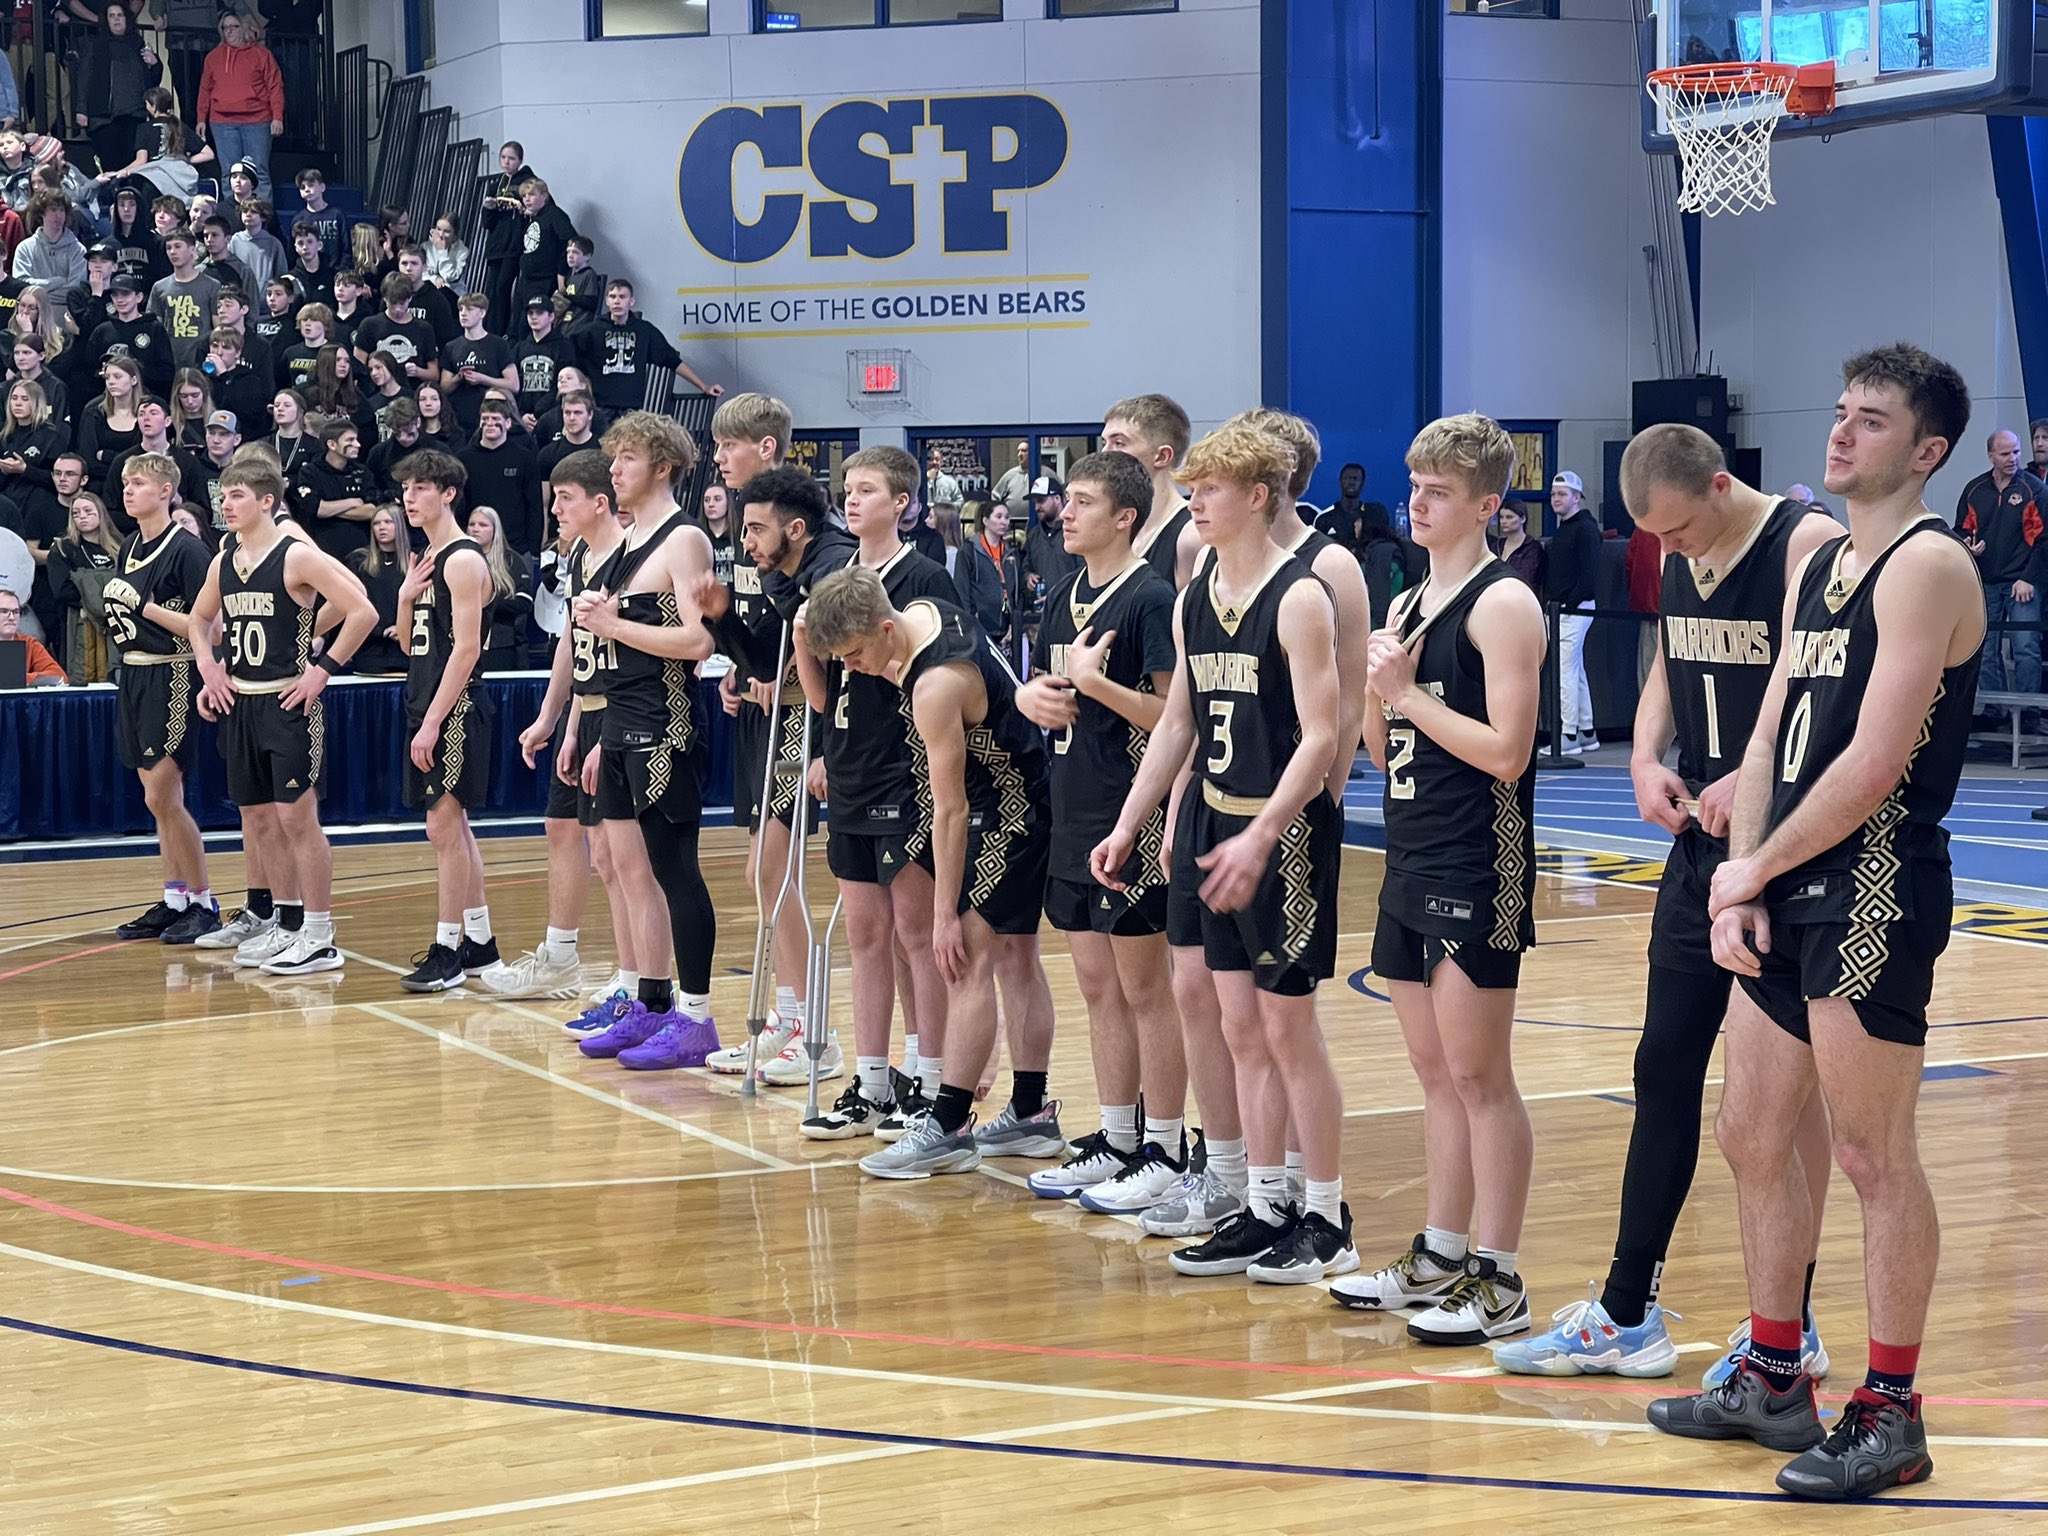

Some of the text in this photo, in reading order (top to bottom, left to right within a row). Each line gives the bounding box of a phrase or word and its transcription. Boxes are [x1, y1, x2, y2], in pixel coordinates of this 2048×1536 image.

[676, 90, 1071, 267] CSP
[683, 290, 1086, 325] HOME OF THE GOLDEN BEARS
[1666, 616, 1771, 665] WARRIORS
[1207, 699, 1235, 775] 3
[1702, 673, 1723, 759] 1
[1782, 691, 1812, 783] 0
[1387, 728, 1416, 800] 2
[1751, 1350, 1801, 1369] Trump
[1768, 1365, 1801, 1376] 2020
